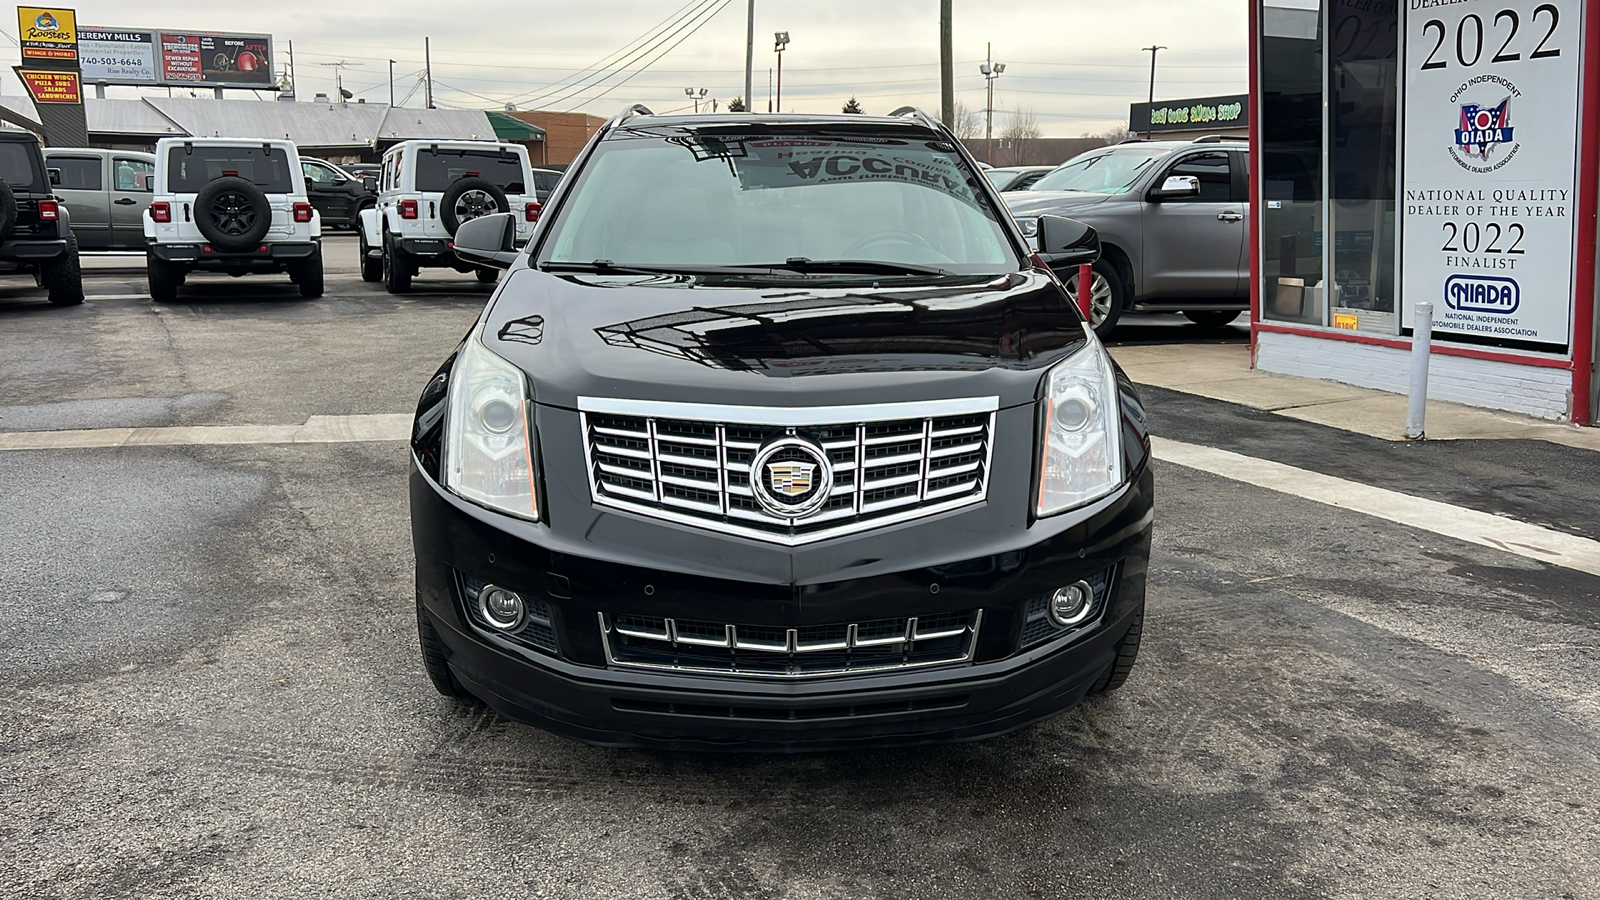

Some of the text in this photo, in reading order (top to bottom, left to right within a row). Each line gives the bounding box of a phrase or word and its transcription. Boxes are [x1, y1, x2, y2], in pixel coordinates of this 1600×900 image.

[1411, 0, 1468, 10] DEAL
[26, 27, 70, 40] Roosters
[77, 32, 141, 41] JEREMY MILLS
[1420, 4, 1561, 70] 2022
[80, 57, 142, 66] 740-503-6648
[1450, 75, 1521, 103] OHIO INDEPENDENT
[1218, 102, 1241, 121] SHOP
[1461, 129, 1503, 143] OIADA
[1448, 147, 1471, 171] AUTOMOBILE
[1494, 143, 1520, 170] ASSOCIATION
[1406, 189, 1569, 203] NATIONAL QUALITY
[1408, 206, 1566, 217] DEALER OF THE YEAR
[1442, 222, 1525, 254] 2022
[1446, 256, 1517, 269] FINALIST
[1450, 283, 1512, 306] NIADA
[1445, 313, 1518, 325] NATIONAL INDEPENDENT
[1432, 321, 1537, 337] UTOMOBILE DEALERS ASSOCIATION
